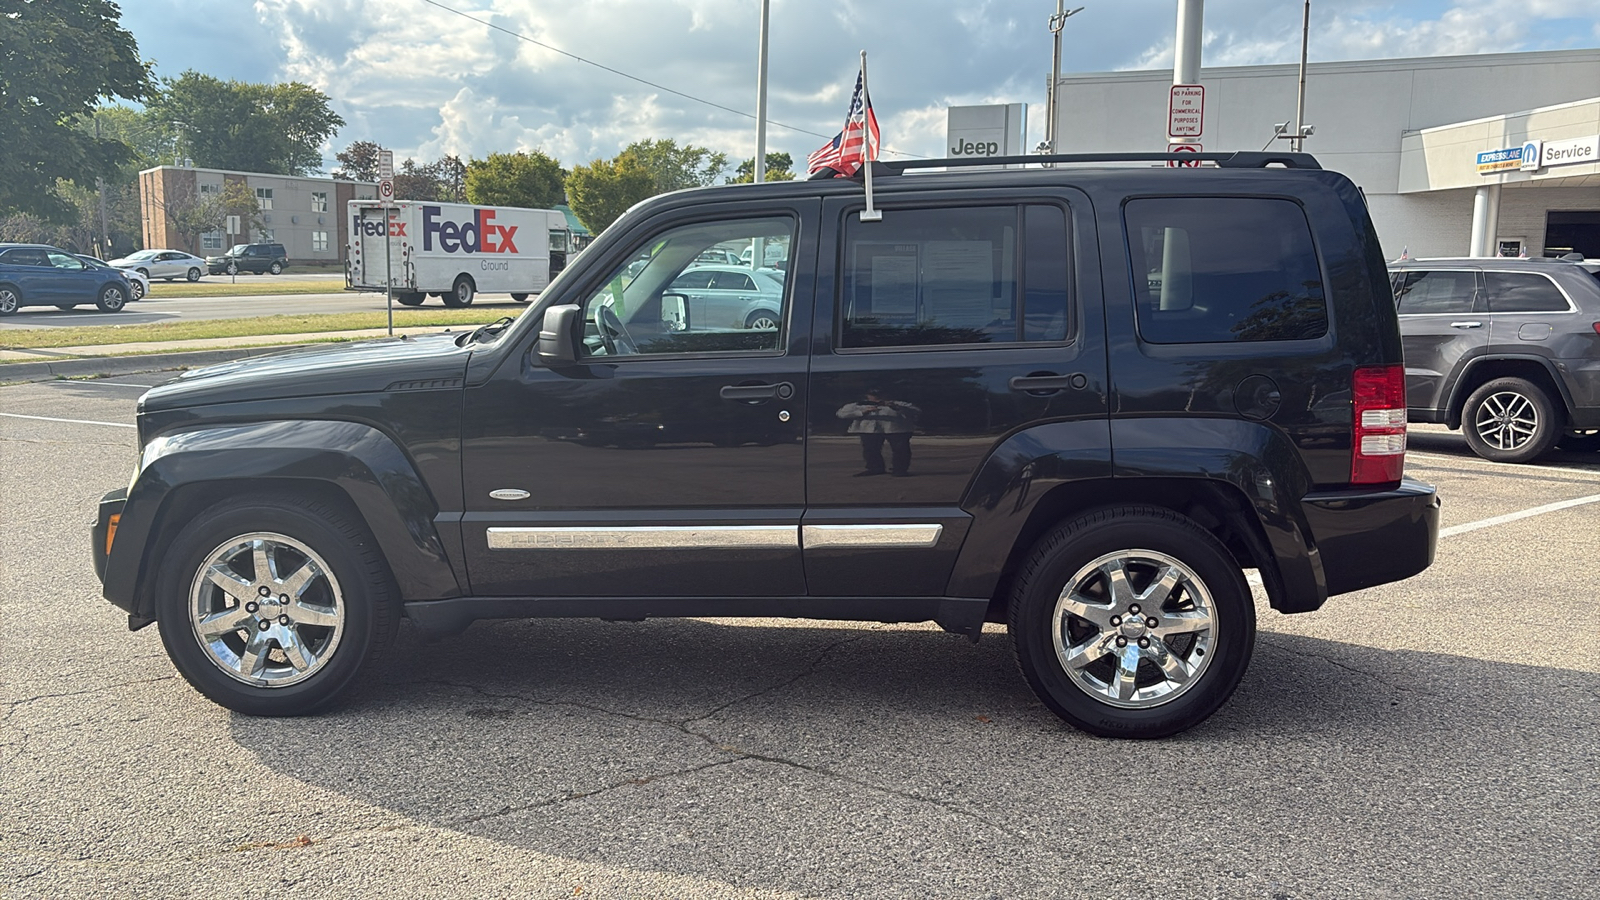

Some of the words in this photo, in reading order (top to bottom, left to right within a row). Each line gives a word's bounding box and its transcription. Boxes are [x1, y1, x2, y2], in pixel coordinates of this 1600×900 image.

[951, 138, 998, 157] Jeep
[1546, 144, 1592, 160] Service
[353, 214, 408, 237] FedEx
[422, 205, 519, 254] FedEx
[481, 259, 509, 271] Ground
[511, 534, 632, 545] LIBERTY
